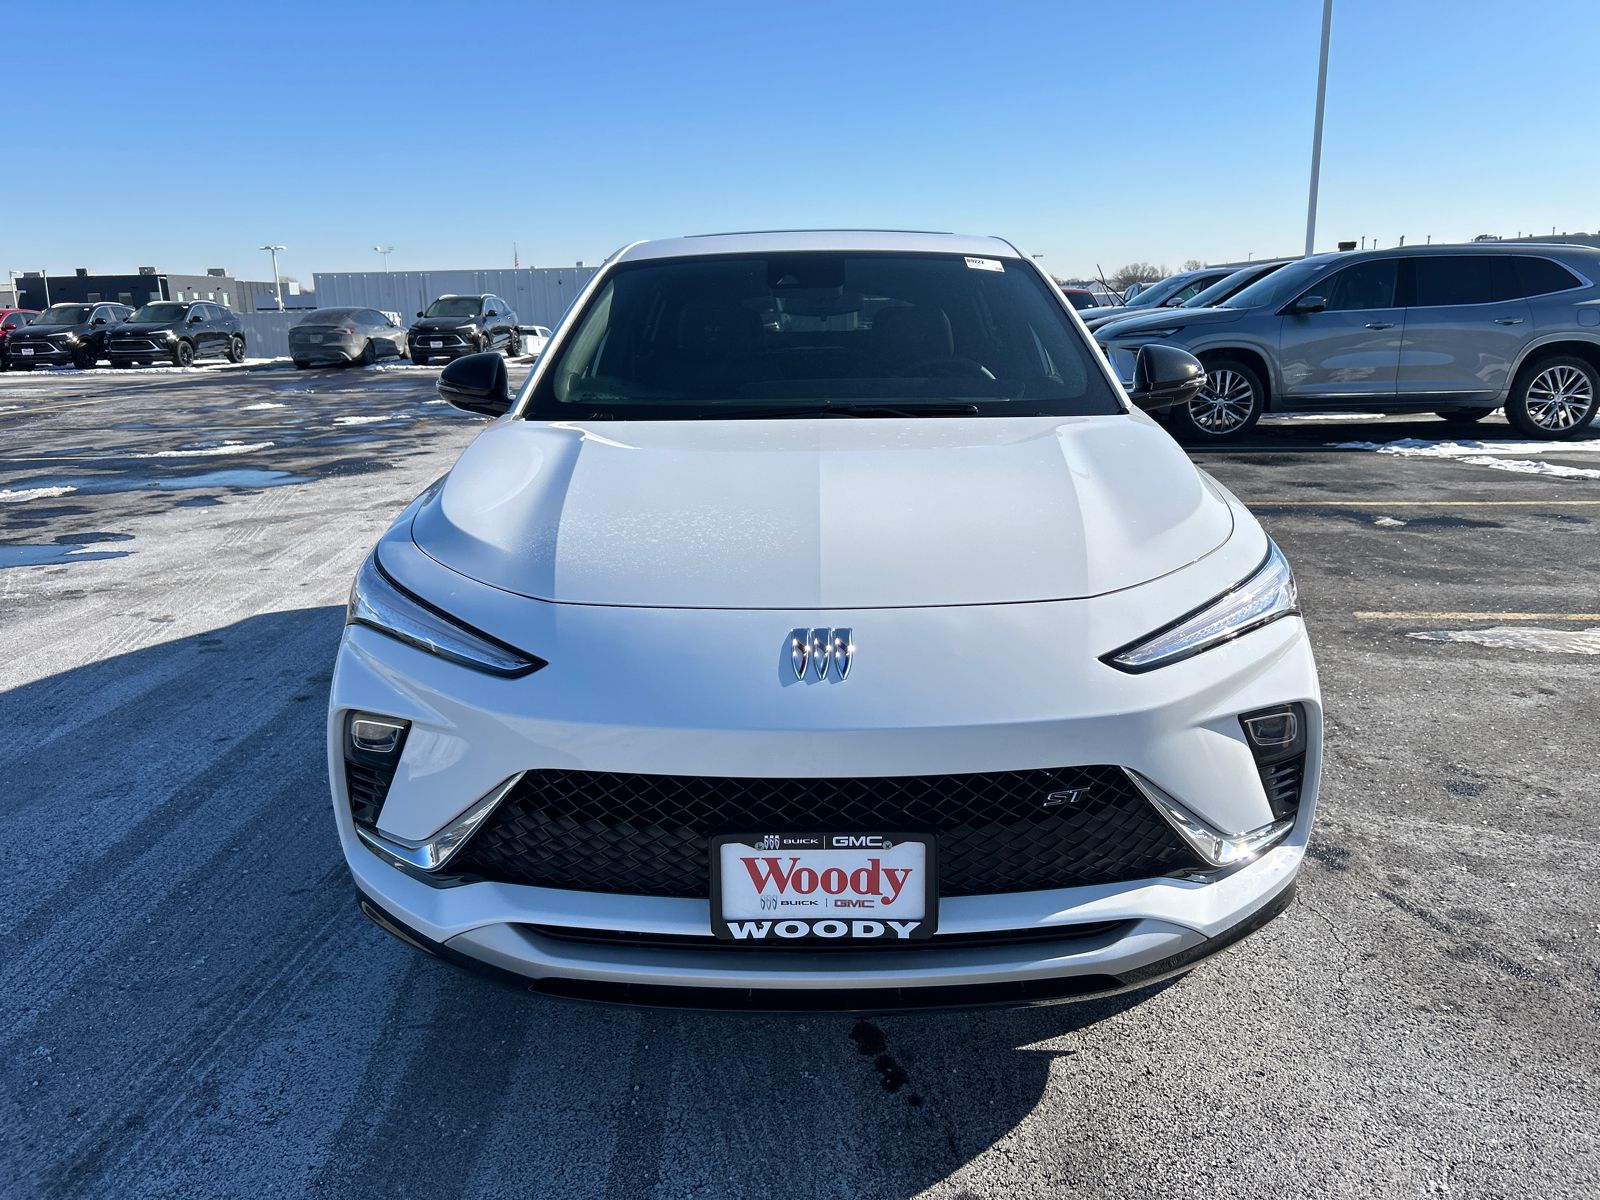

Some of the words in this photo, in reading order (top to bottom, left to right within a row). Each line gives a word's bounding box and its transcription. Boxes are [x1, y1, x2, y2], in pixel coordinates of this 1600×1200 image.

[1043, 786, 1091, 807] ST
[832, 836, 883, 847] GMC
[740, 857, 912, 905] Woody
[833, 899, 875, 908] GMC
[727, 920, 921, 939] WOODY
